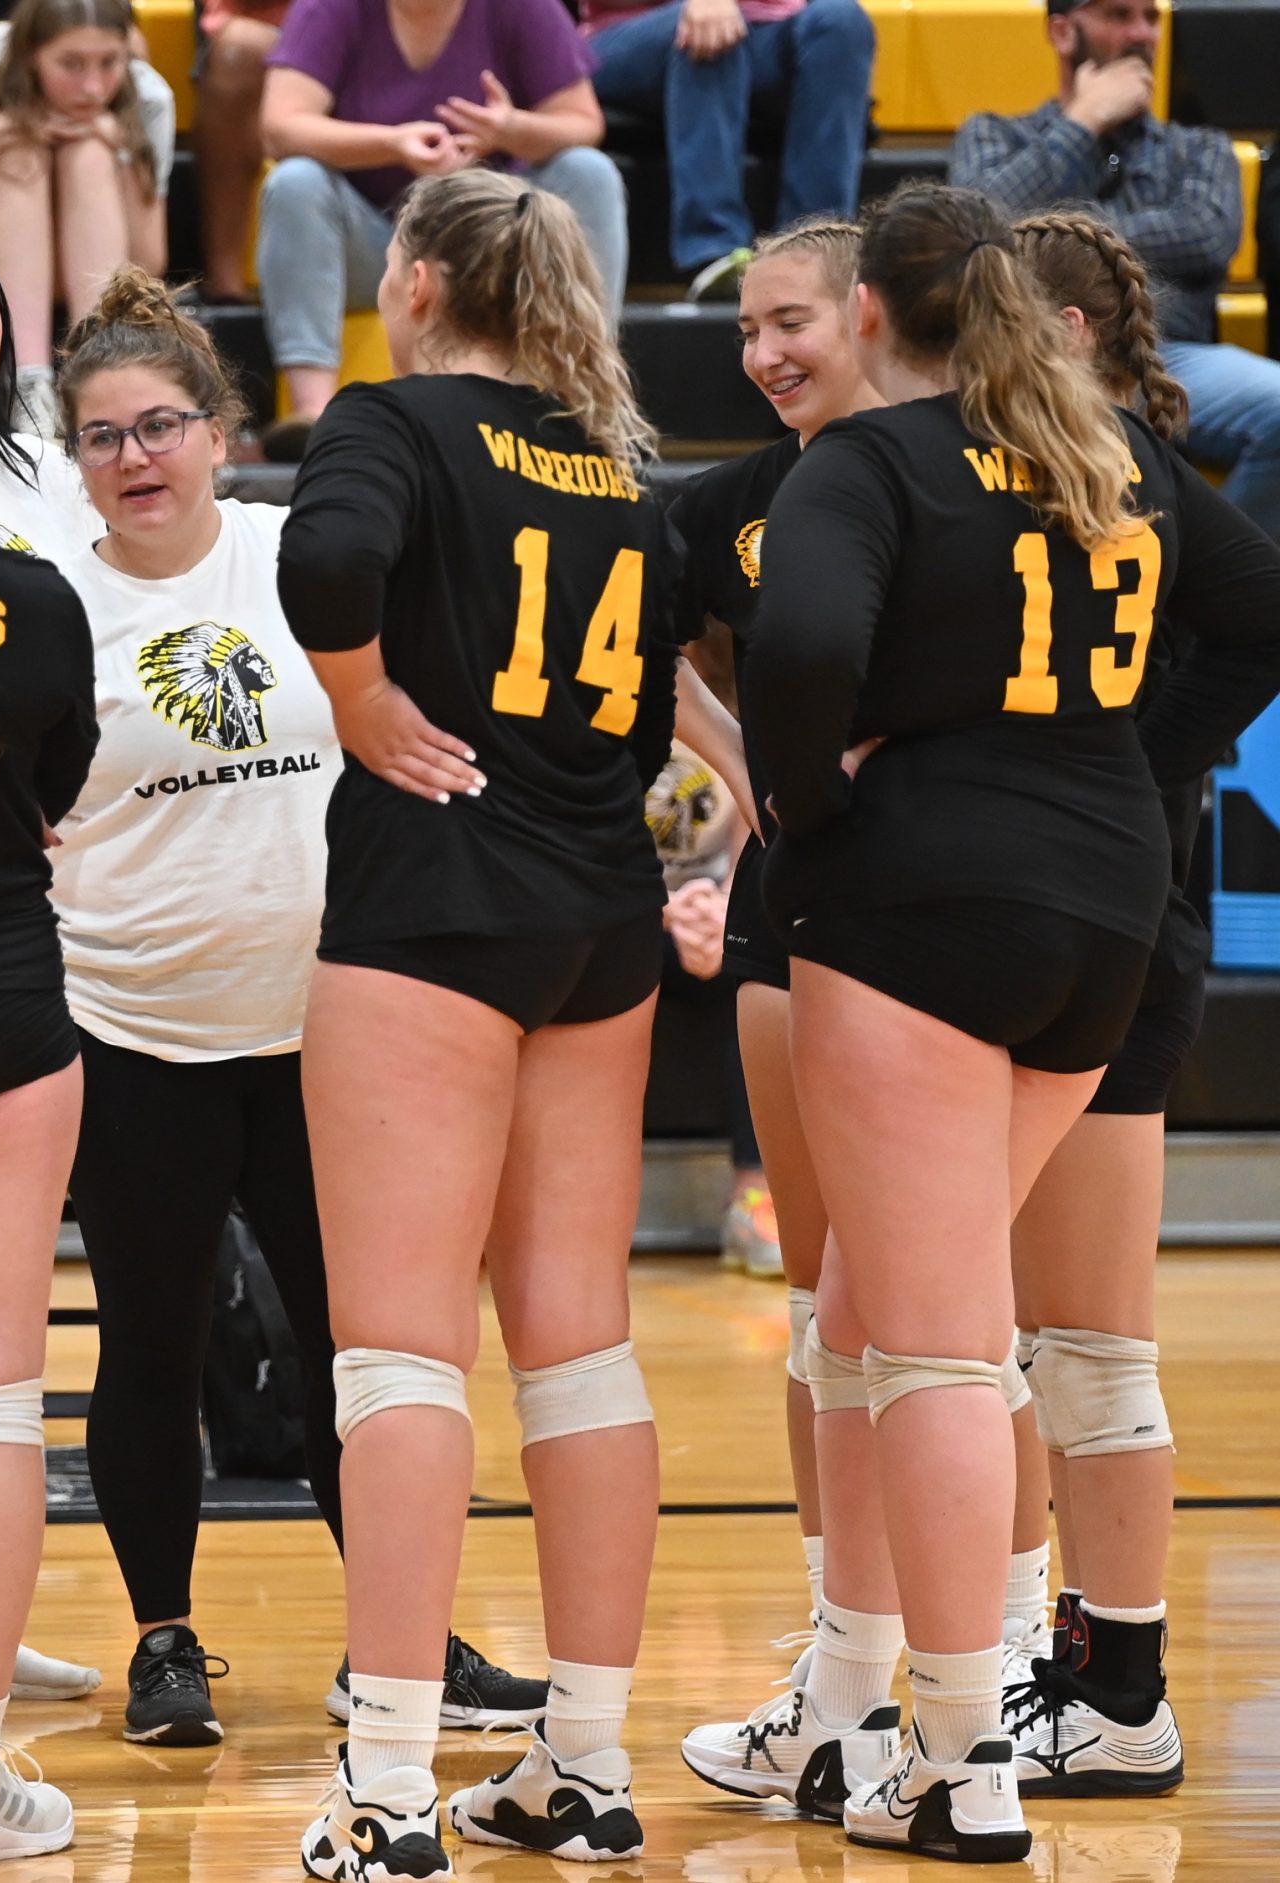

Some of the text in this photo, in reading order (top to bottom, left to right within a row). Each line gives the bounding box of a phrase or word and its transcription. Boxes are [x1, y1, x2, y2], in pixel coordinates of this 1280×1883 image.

[492, 526, 644, 737] 14
[1002, 522, 1162, 714] 13
[135, 752, 321, 799] VOLLEYBALL
